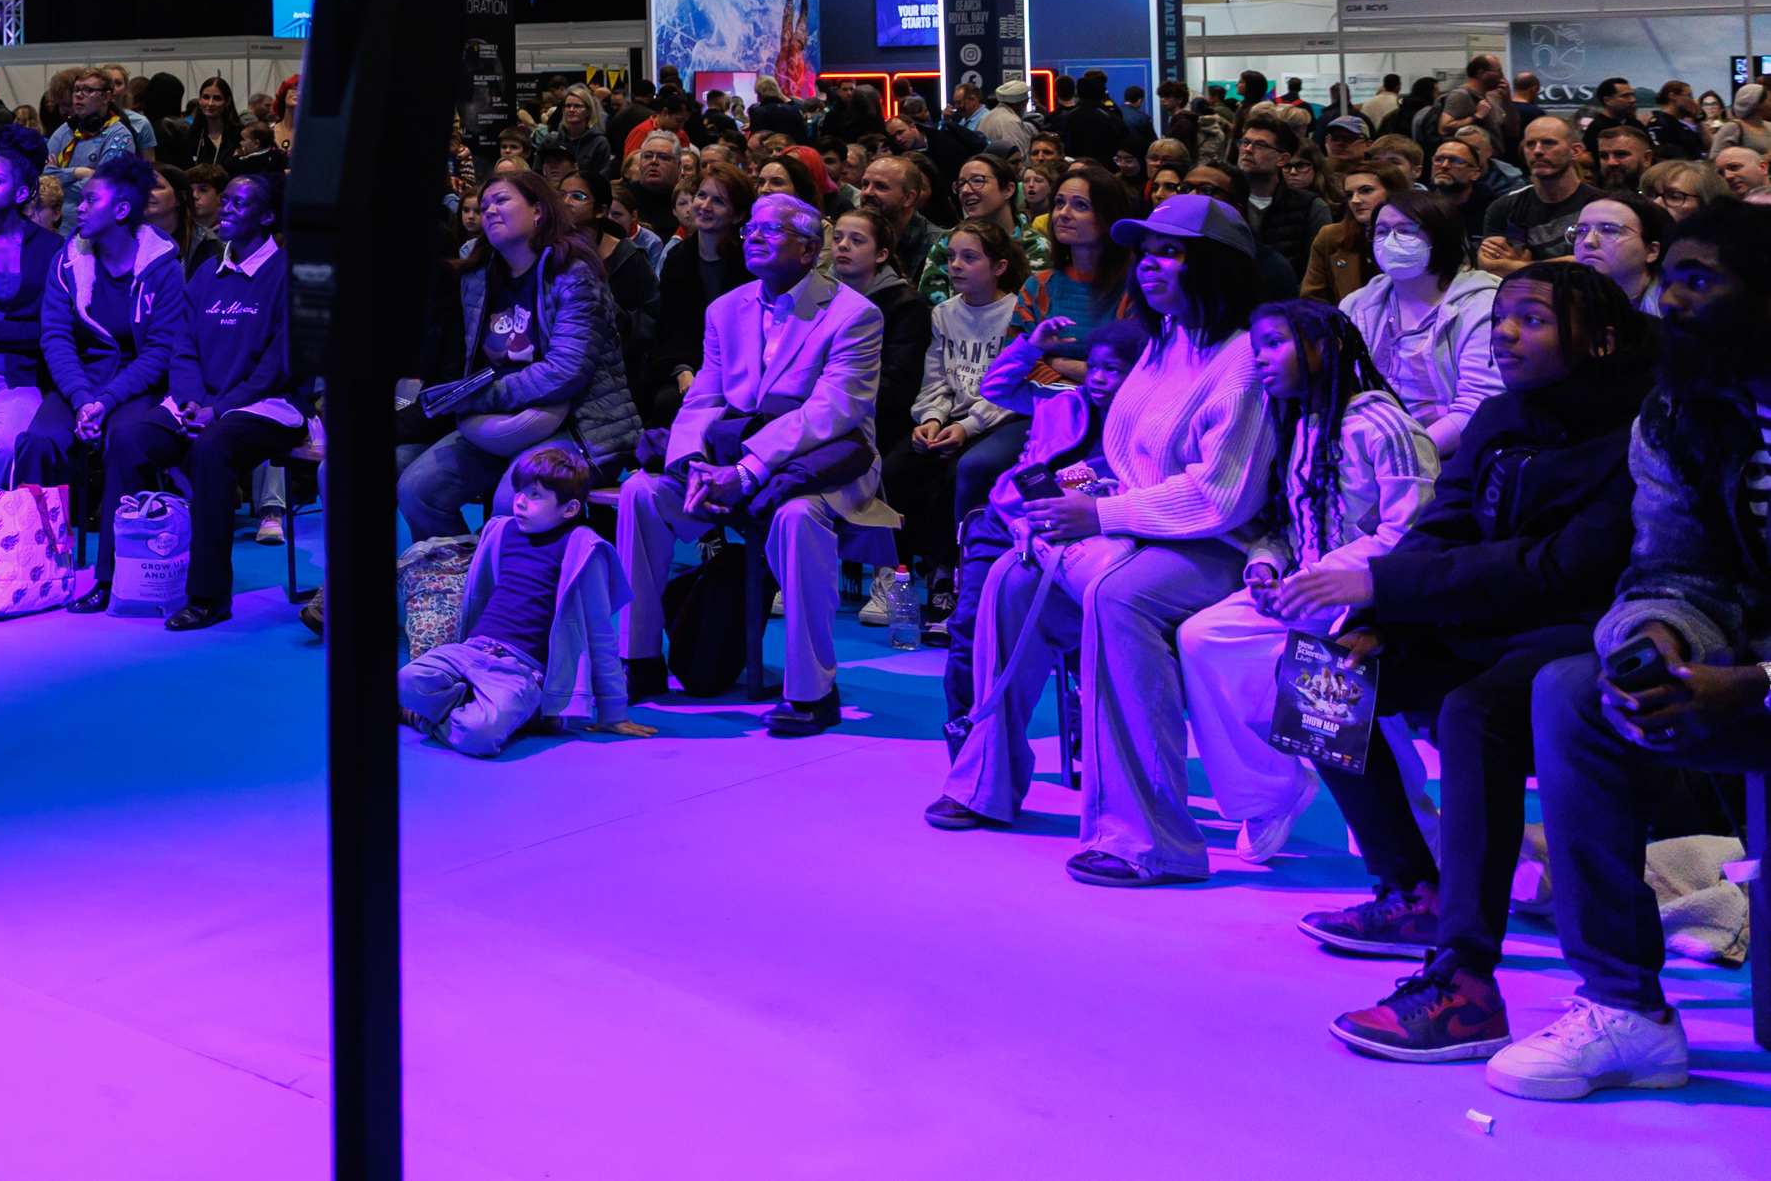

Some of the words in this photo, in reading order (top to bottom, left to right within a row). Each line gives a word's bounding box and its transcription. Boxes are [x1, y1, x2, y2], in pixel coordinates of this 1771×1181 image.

[466, 0, 509, 15] ORATION
[898, 5, 920, 17] YOUR
[955, 0, 982, 12] SEARCH
[901, 17, 931, 29] STARTS
[948, 12, 970, 24] ROYAL
[971, 11, 989, 23] NAVY
[955, 23, 985, 36] CAREERS
[999, 17, 1008, 39] FIND
[1008, 14, 1016, 39] YOUR
[1165, 41, 1177, 60] IN
[140, 562, 170, 571] GROW
[1298, 639, 1315, 651] New
[1295, 653, 1313, 664] Live
[1296, 646, 1331, 662] Scientist
[1301, 713, 1324, 729] SHOW
[1322, 720, 1340, 734] MAP
